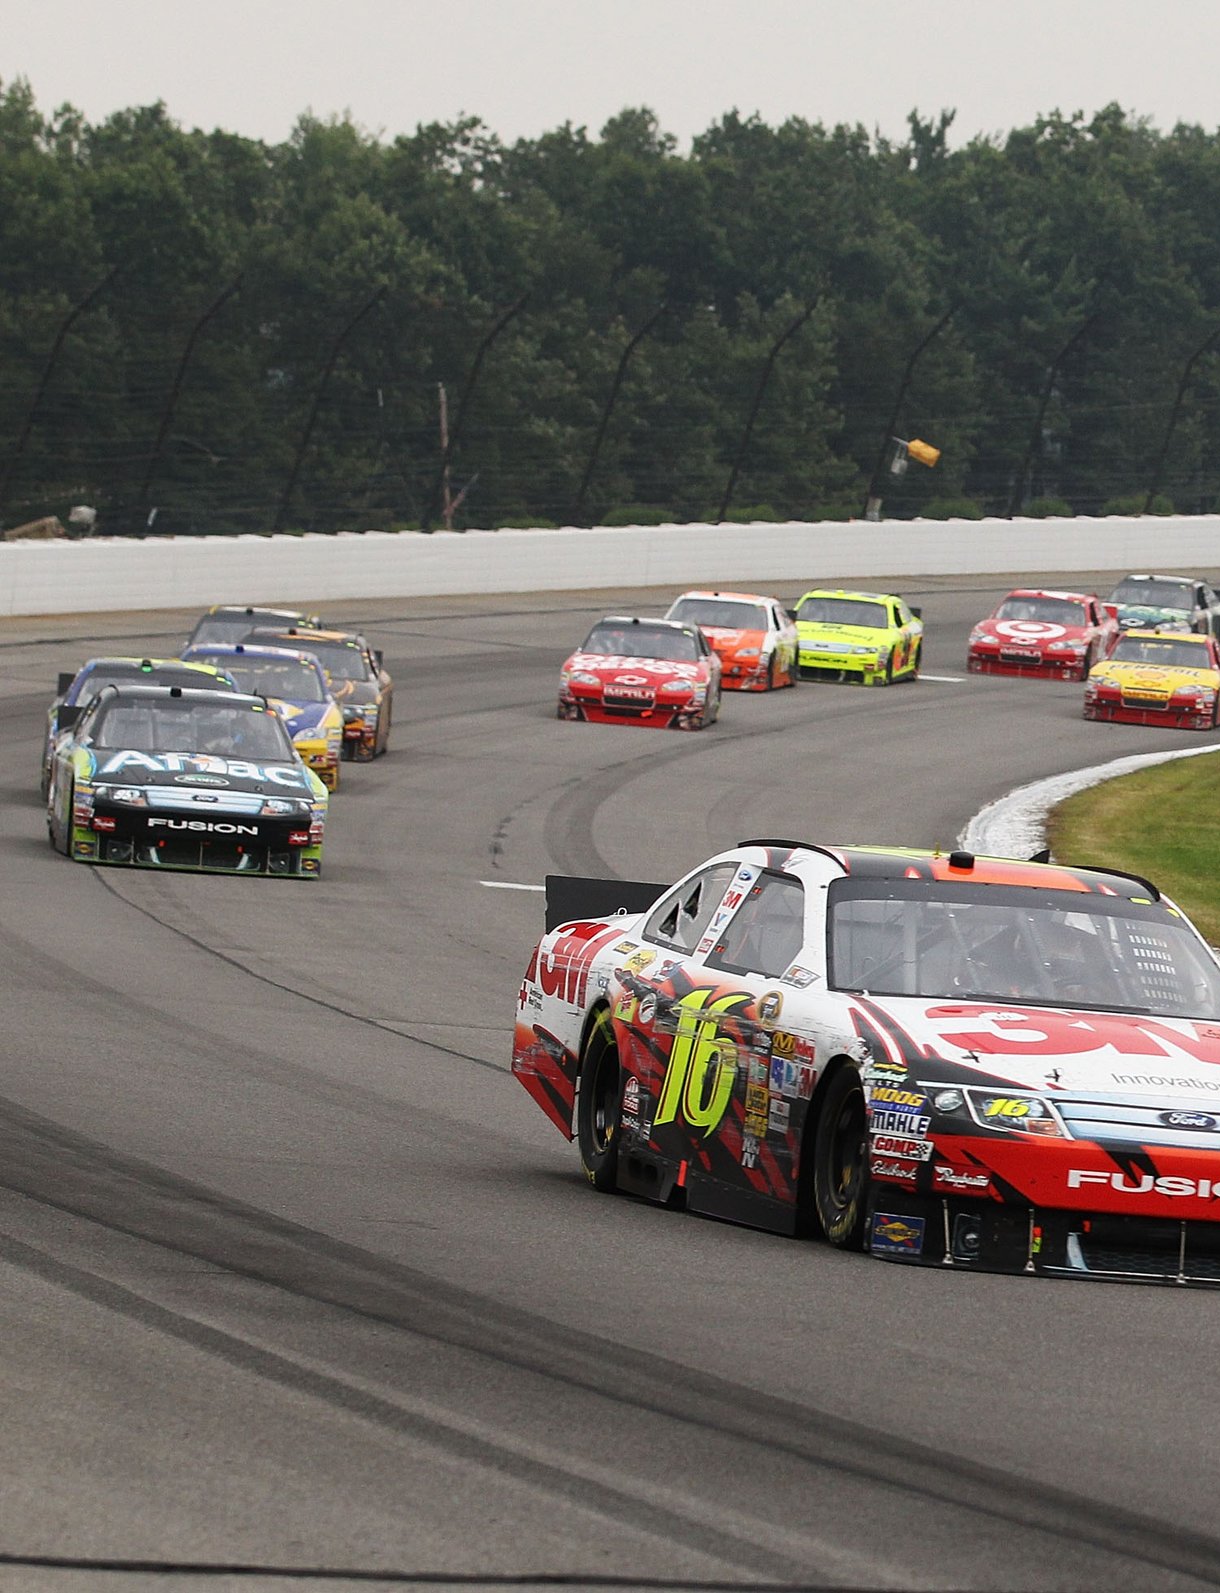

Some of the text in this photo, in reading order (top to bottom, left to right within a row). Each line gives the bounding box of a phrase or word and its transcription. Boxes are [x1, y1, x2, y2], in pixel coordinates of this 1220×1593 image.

[603, 687, 656, 698] IMPALA
[148, 818, 258, 836] FUSION
[653, 988, 752, 1140] 16
[871, 1087, 927, 1107] MOOG
[985, 1098, 1030, 1117] 16
[872, 1111, 928, 1135] MAHLE
[1168, 1110, 1210, 1128] Ford
[874, 1137, 916, 1153] COMP
